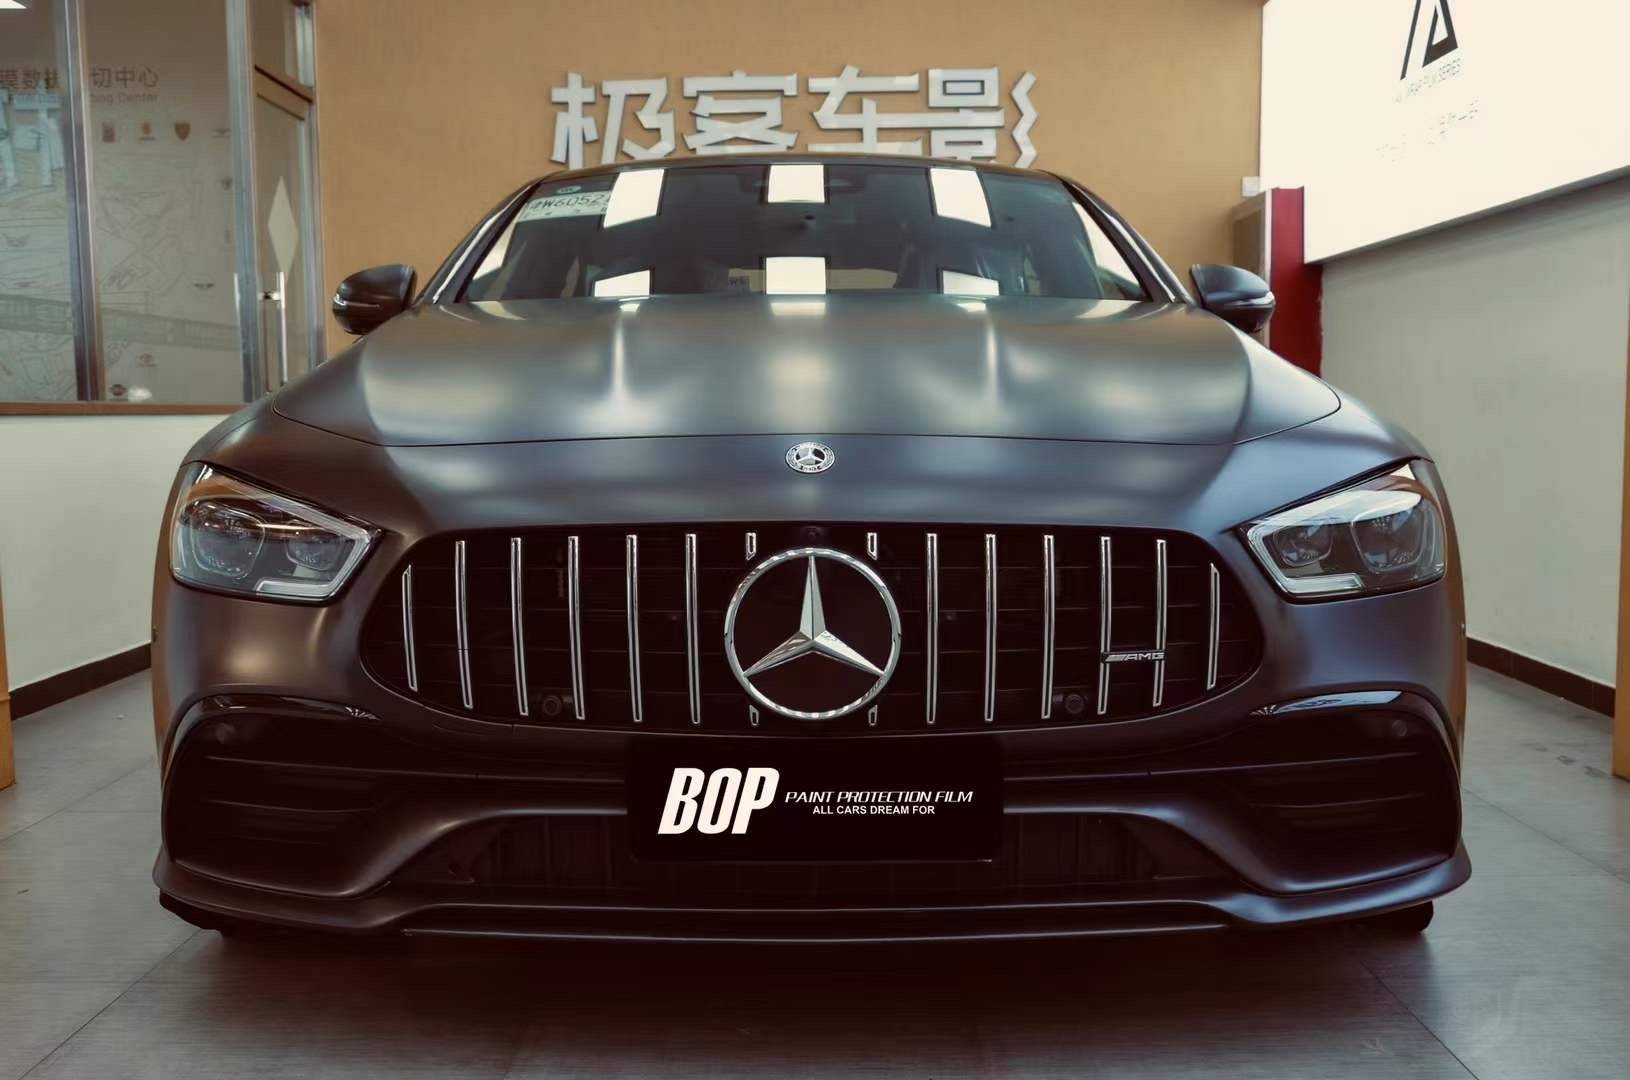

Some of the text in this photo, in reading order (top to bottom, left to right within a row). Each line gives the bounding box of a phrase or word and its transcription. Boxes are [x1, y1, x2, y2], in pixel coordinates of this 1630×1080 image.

[550, 65, 1038, 170] 极客车影
[1123, 652, 1165, 662] AMG
[657, 767, 780, 835] BOP
[785, 790, 974, 803] PAINT PROTECTION FILM
[812, 805, 936, 815] ALL CARS DREAM FOR
